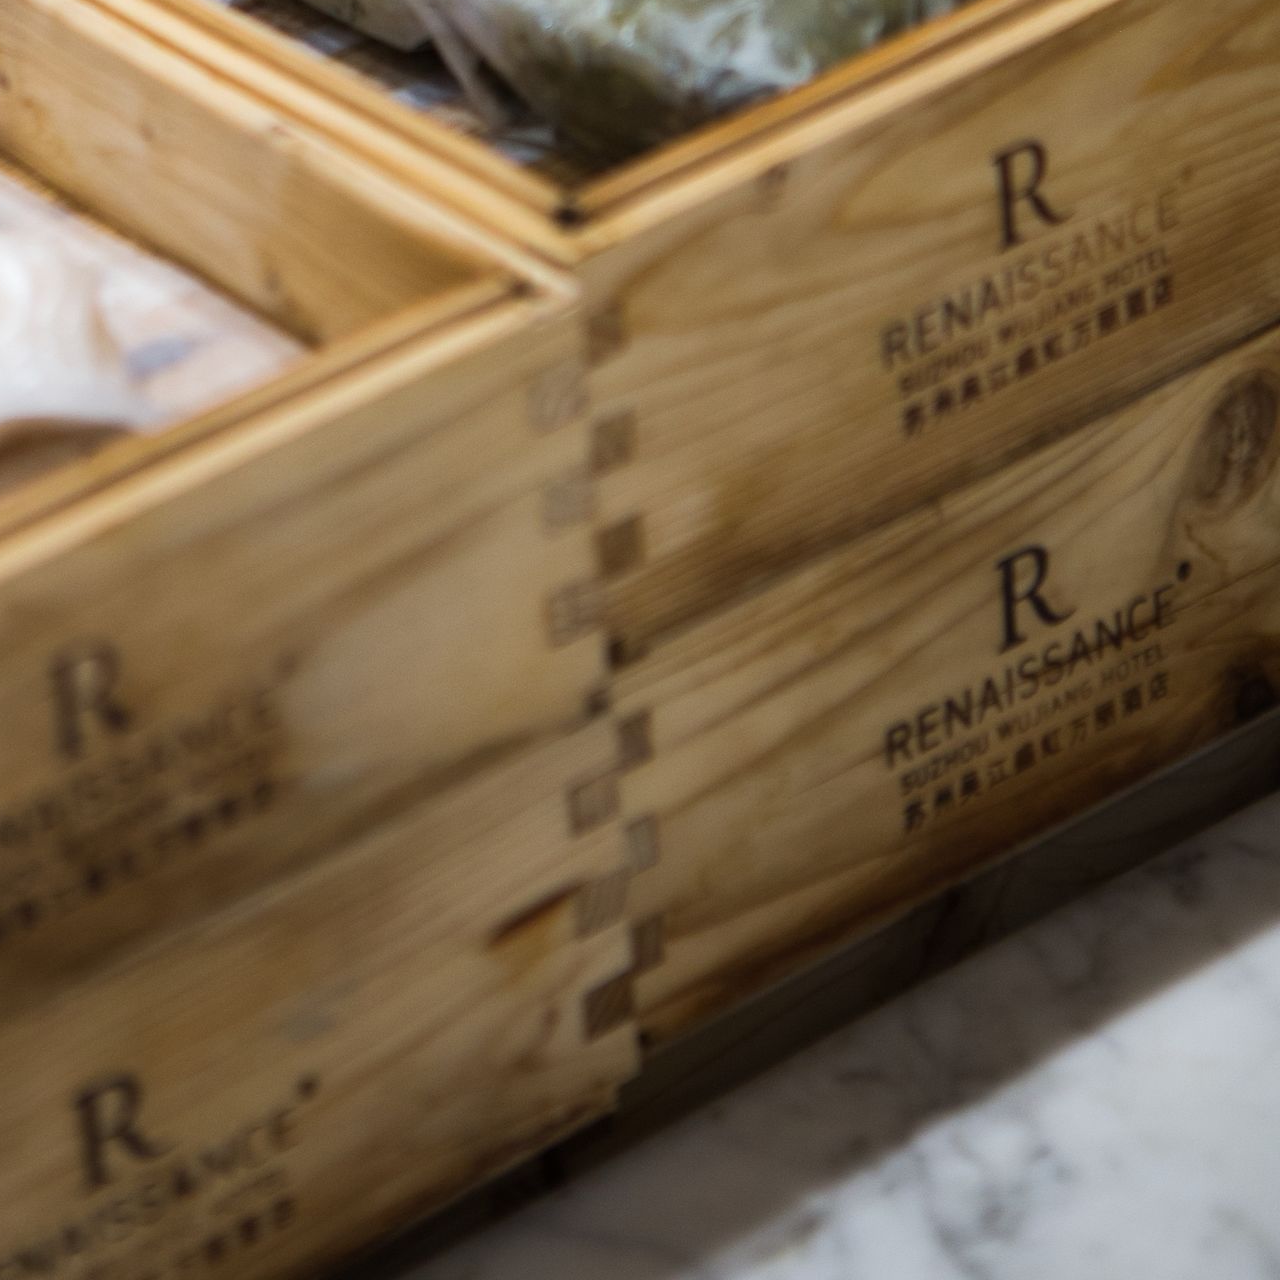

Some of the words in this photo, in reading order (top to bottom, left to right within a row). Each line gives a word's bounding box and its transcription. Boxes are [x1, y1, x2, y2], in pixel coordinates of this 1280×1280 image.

[993, 138, 1074, 252] R
[880, 185, 1181, 371] RENAISSANCE
[995, 543, 1078, 655] R
[48, 644, 136, 760] R
[883, 582, 1178, 771] RENAISSANCE
[71, 1072, 158, 1192] R
